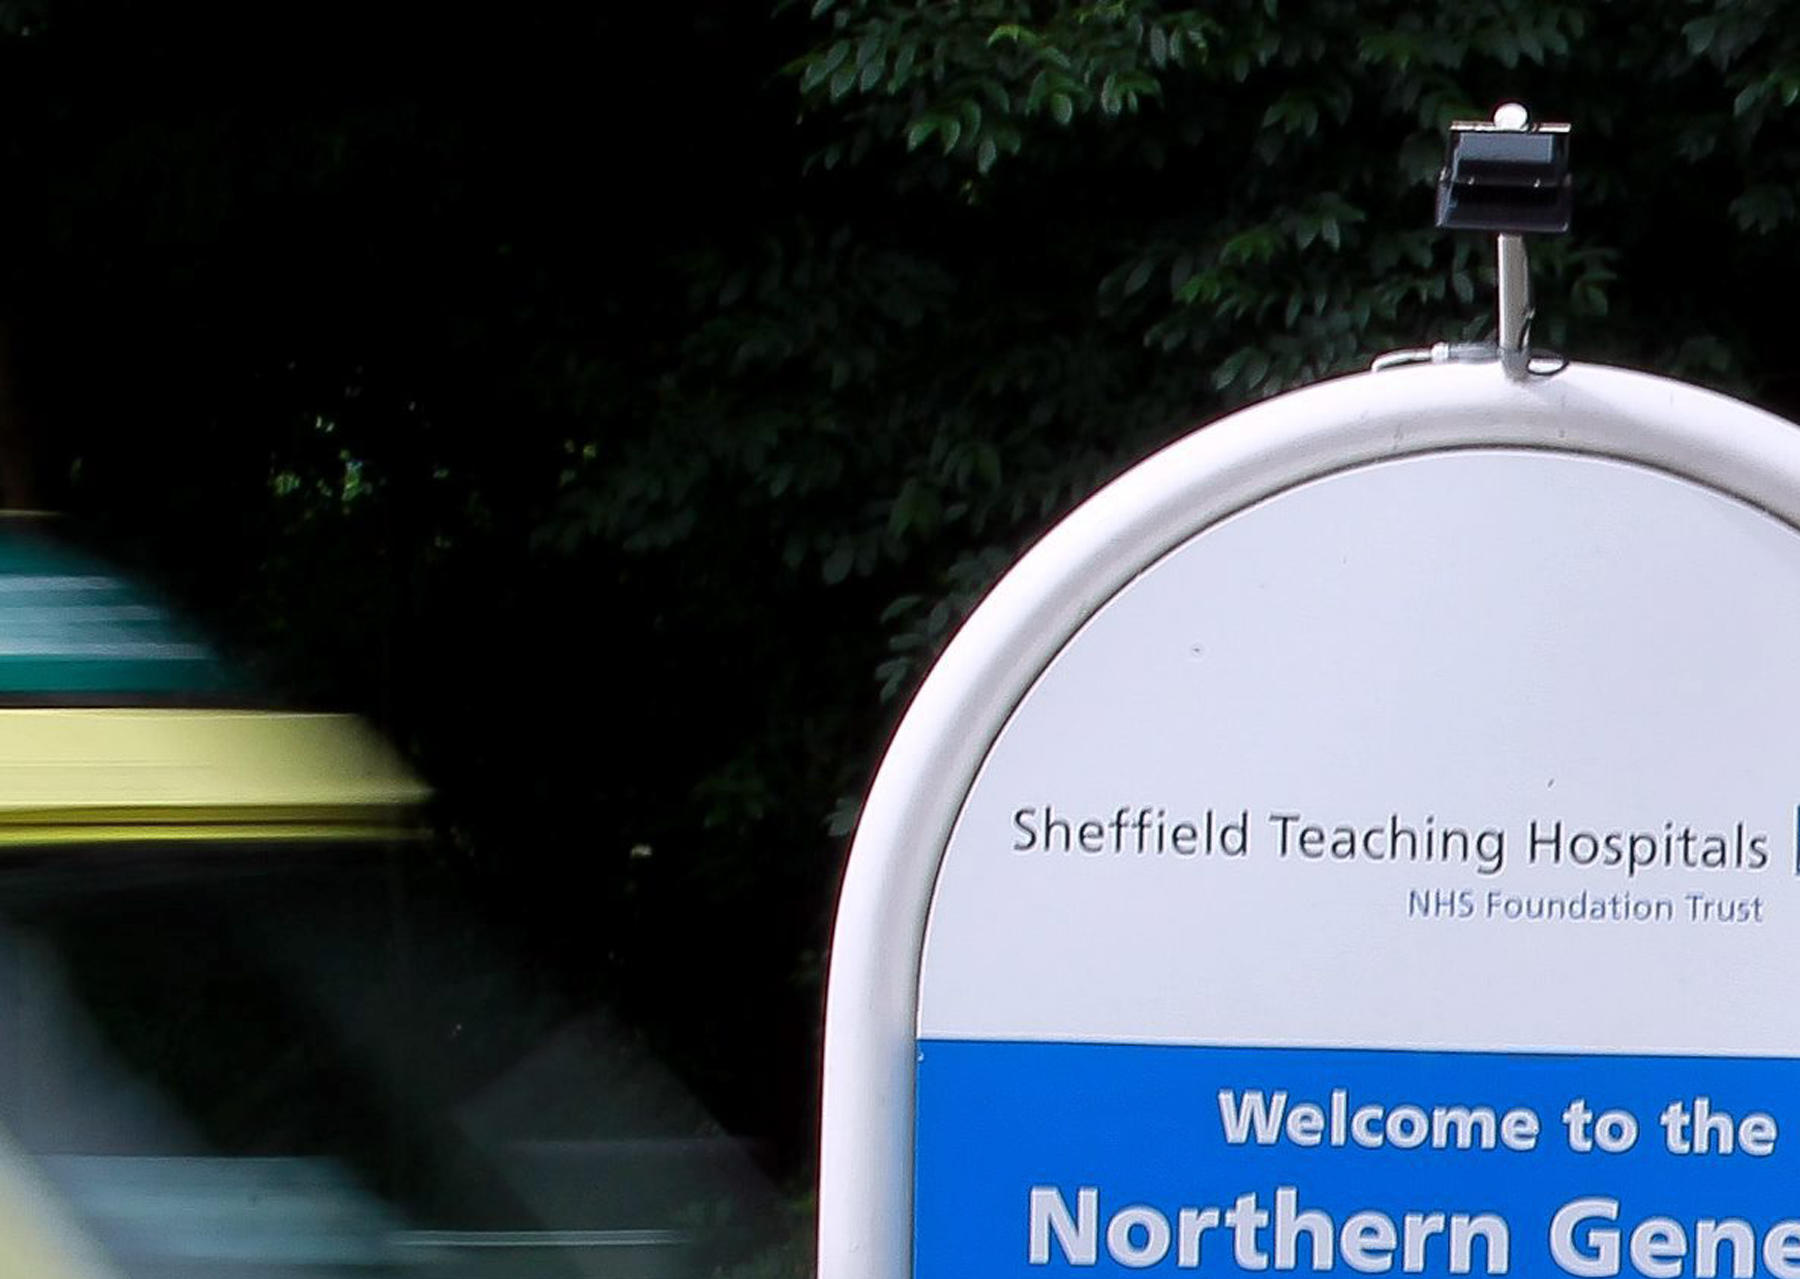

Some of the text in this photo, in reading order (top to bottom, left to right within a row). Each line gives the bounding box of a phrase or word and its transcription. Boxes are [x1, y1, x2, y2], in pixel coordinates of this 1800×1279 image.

[1013, 804, 1249, 857] Sheffield
[1268, 812, 1505, 876] Teaching
[1529, 819, 1769, 879] Hospitals
[1408, 887, 1763, 923] NHS Foundation Trust
[1218, 1088, 1777, 1156] Welcome to the
[1029, 1186, 1509, 1274] Northern
